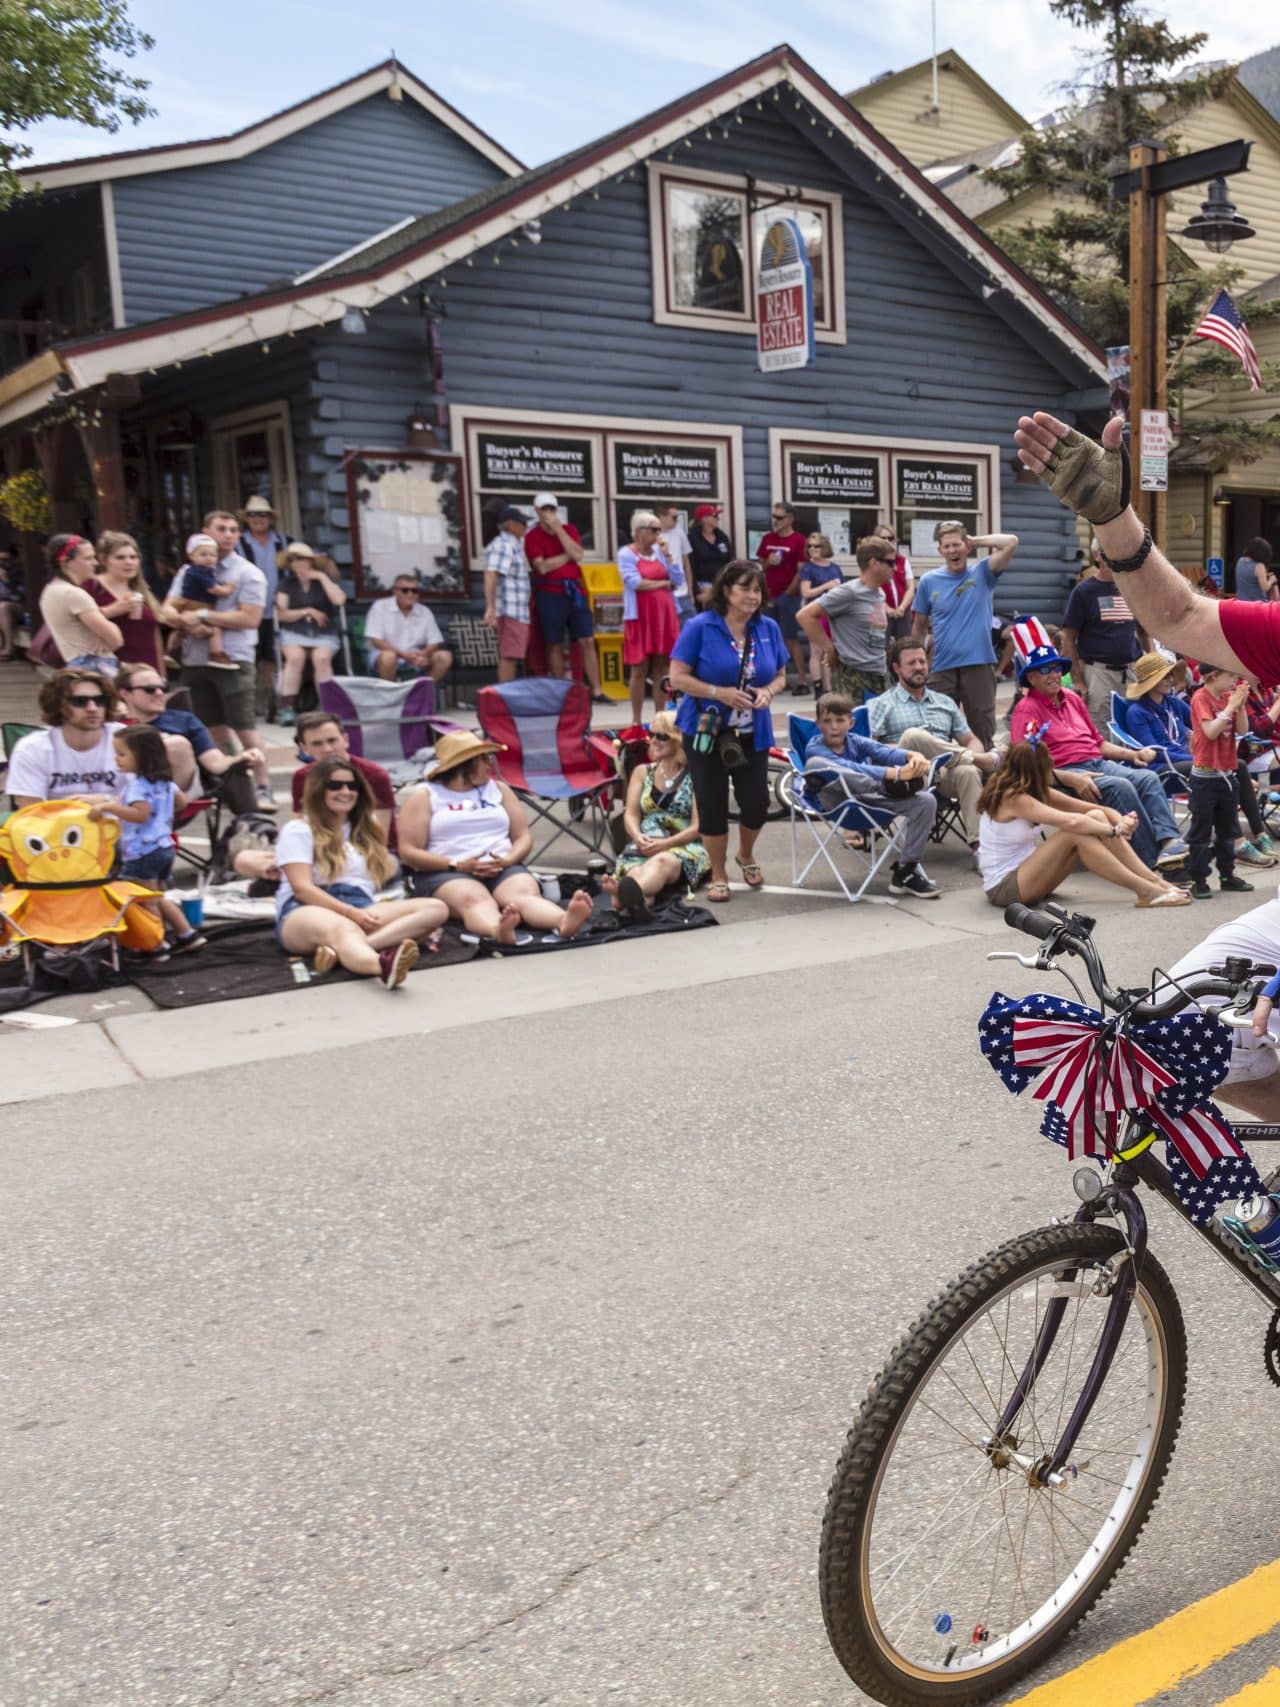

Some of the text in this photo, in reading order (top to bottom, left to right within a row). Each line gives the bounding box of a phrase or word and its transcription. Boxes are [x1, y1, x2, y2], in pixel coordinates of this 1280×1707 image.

[766, 289, 797, 321] REAL
[762, 318, 803, 350] ESTATE
[486, 444, 583, 461] Buyer's Resource
[622, 452, 710, 468] Buyer's Resource
[488, 458, 583, 474] EBY REAL ESTATE
[624, 466, 710, 480] EBY REAL ESTATE
[797, 462, 874, 476] Buyer's Resource
[797, 475, 874, 488] EBY REAL ESTATE
[903, 468, 973, 482] Buyer's Resource
[904, 481, 972, 493] EBY REAL ESTATE
